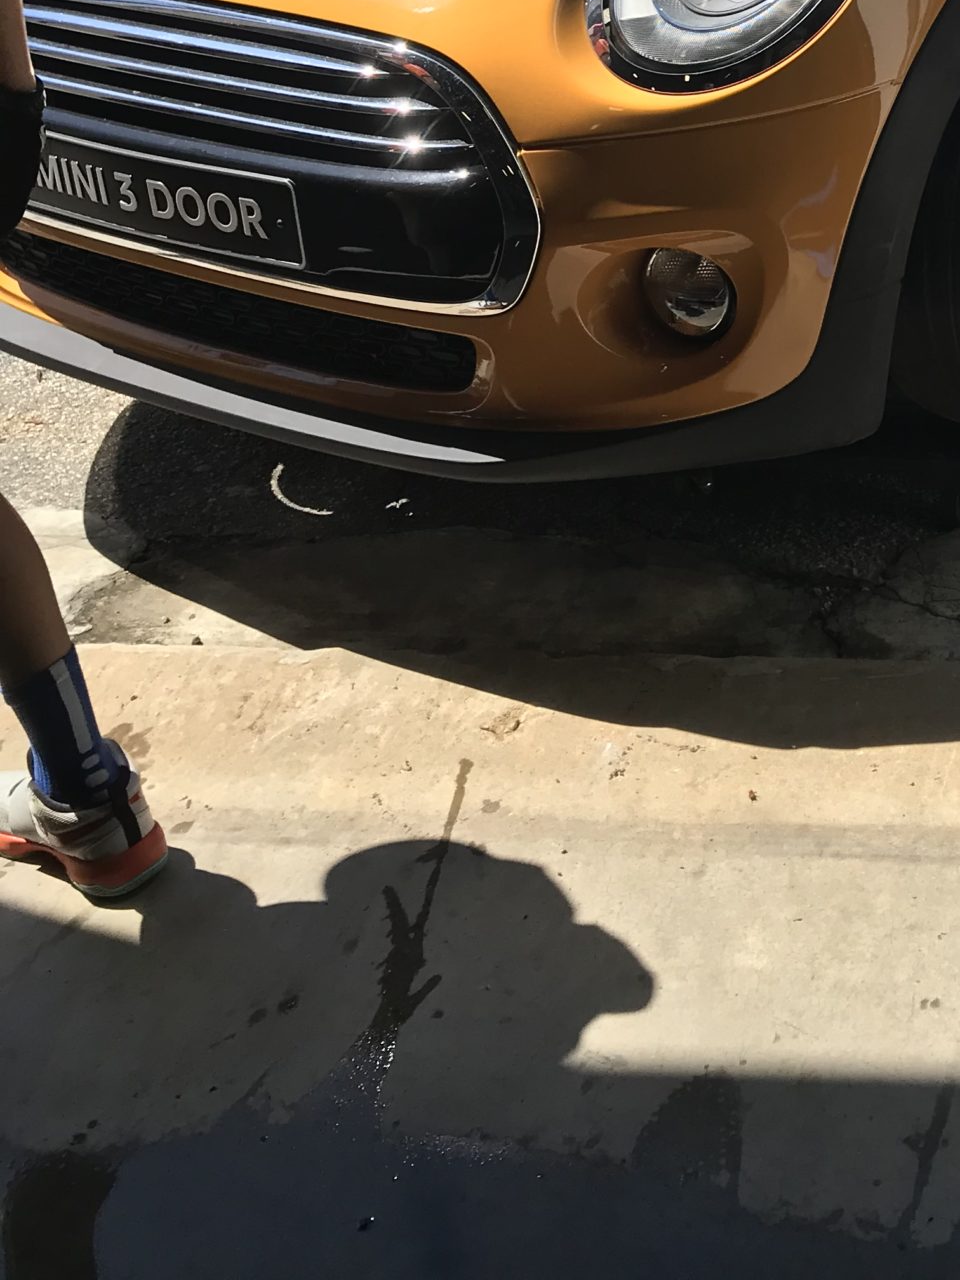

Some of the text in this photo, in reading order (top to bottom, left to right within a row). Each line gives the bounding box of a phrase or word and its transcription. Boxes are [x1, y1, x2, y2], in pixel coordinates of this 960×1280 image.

[37, 154, 269, 240] MINI 3 DOOR
